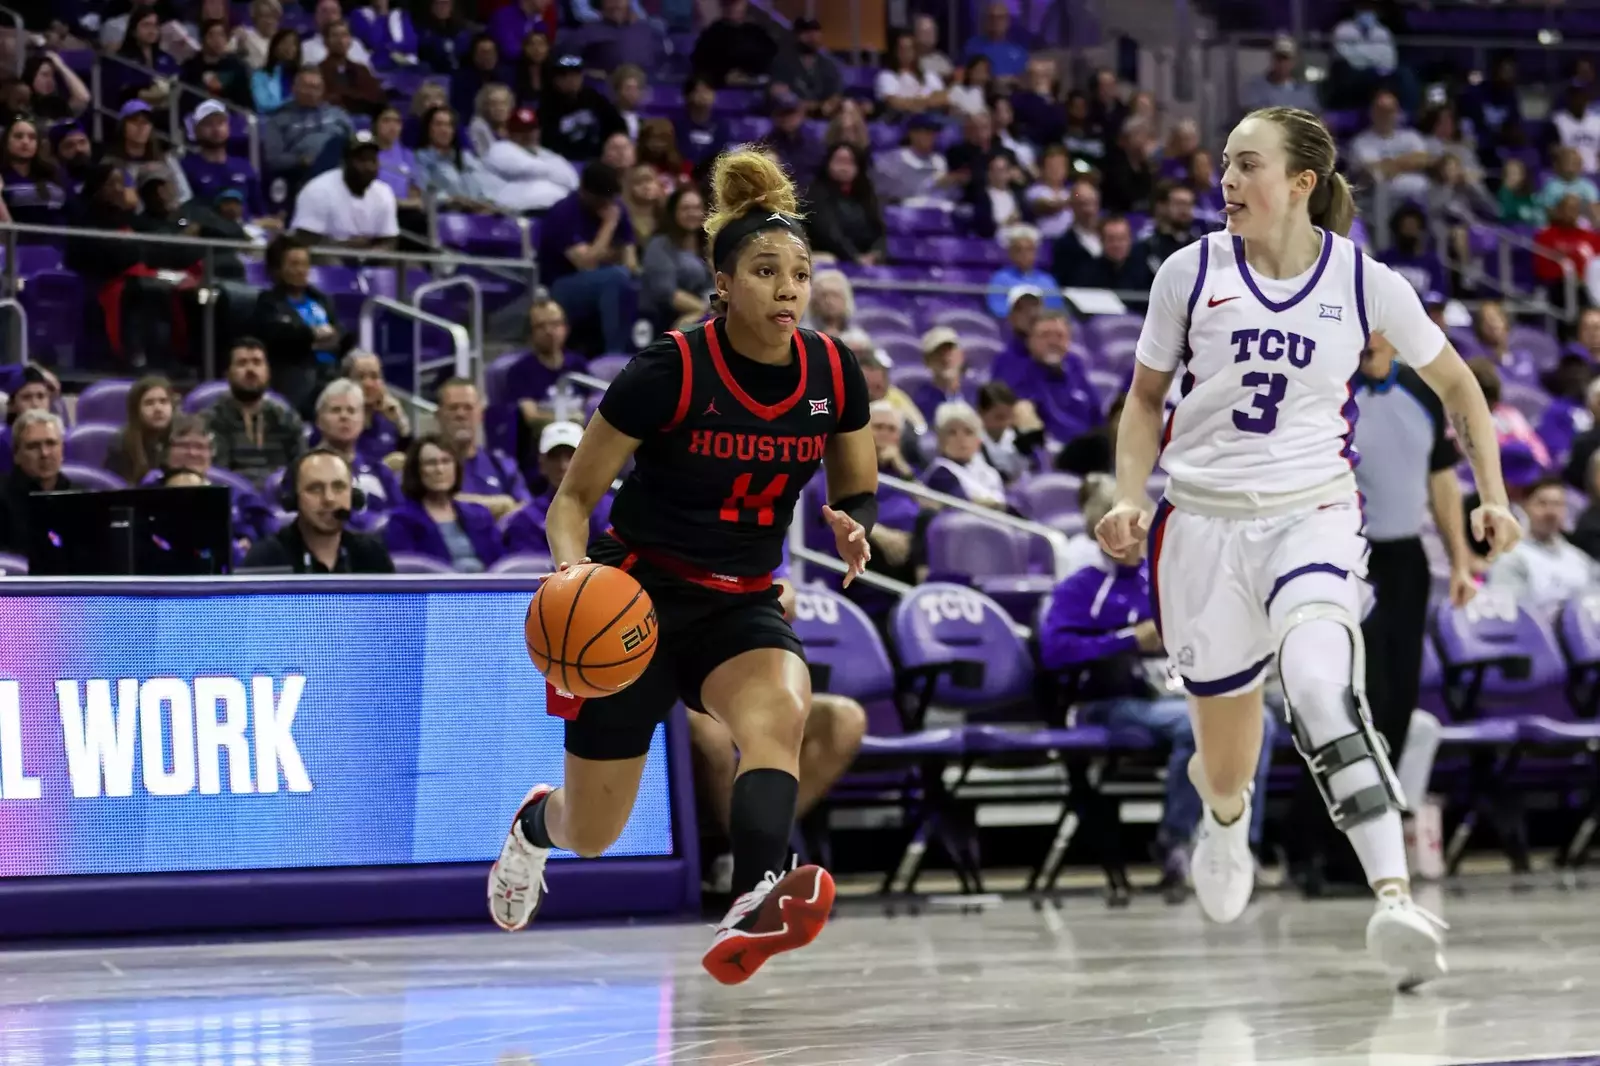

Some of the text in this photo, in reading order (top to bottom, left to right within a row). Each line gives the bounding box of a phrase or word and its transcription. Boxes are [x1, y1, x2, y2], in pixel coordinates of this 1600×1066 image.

[1231, 328, 1316, 369] TCU
[1232, 371, 1288, 434] 3
[688, 429, 827, 463] HOUSTON
[719, 472, 790, 526] 14
[621, 607, 657, 653] ELIT
[919, 590, 985, 625] TCU
[55, 675, 314, 798] WORK
